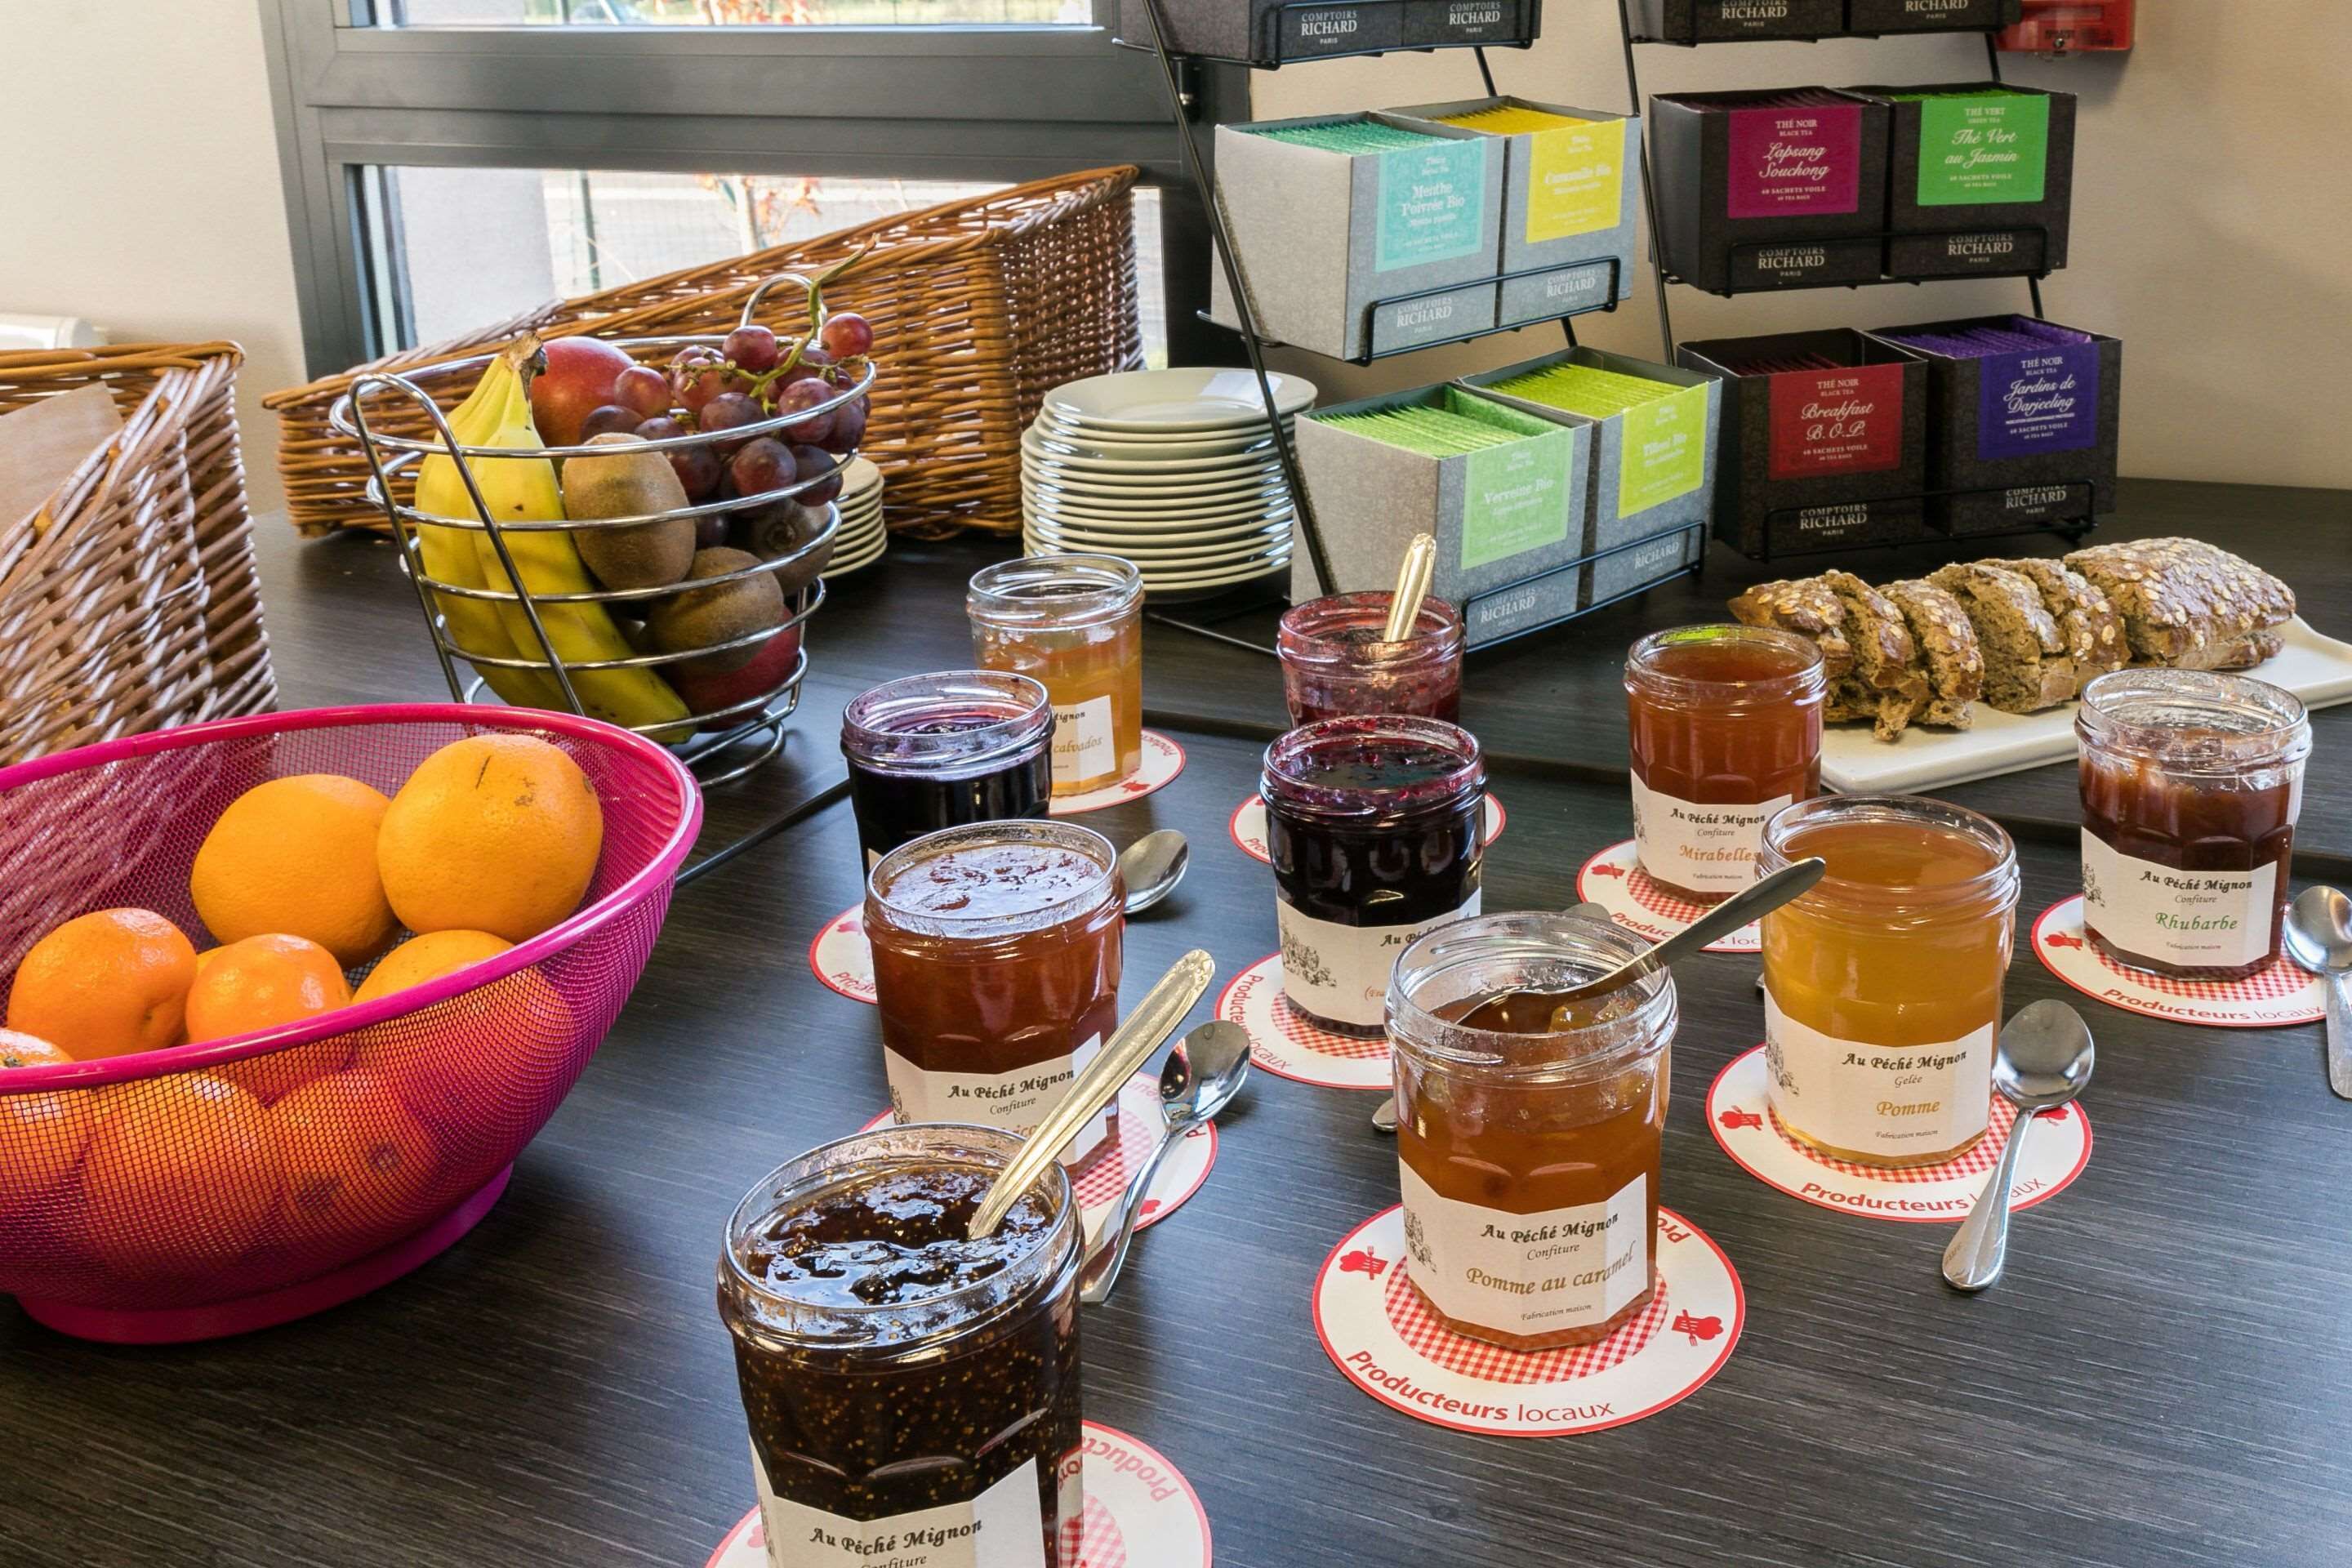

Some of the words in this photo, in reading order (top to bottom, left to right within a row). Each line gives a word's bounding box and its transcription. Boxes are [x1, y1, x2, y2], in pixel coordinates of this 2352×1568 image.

[1449, 11, 1500, 25] RICHARD
[1722, 7, 1788, 20] RICHARD
[1301, 20, 1357, 37] RICHARD
[1965, 107, 1982, 116] THÉ
[1984, 107, 2006, 115] VERT
[1775, 118, 1794, 129] THÉ
[1796, 119, 1818, 128] NOIR
[1952, 129, 1981, 145] Thé
[1986, 128, 2018, 144] Vert
[1762, 142, 1826, 163] Lapsang
[1944, 154, 1965, 164] au
[1962, 148, 2018, 169] Jasmin
[1759, 161, 1829, 181] Souchong
[1412, 183, 1453, 198] Menthe
[1948, 242, 2013, 256] RICHARD
[1758, 256, 1824, 270] RICHARD
[1547, 277, 1595, 297] RICHARD
[1396, 305, 1451, 327] RICHARD
[2020, 358, 2039, 368] THÉ
[2042, 356, 2063, 366] NOIR
[1816, 380, 1836, 390] THÉ
[1838, 378, 1859, 388] NOIR
[2003, 377, 2059, 402] Jardins
[2060, 373, 2077, 390] de
[1801, 399, 1874, 421] Breakfast
[2007, 393, 2076, 416] Darjeeling
[2005, 490, 2067, 509] RICHARD
[1799, 512, 1868, 530] RICHARD
[1634, 542, 1679, 570] RICHARD
[1480, 596, 1535, 623] RICHARD
[1670, 808, 1685, 819] Au
[1687, 813, 1719, 824] Péché
[1722, 814, 1766, 827] Mignon
[1697, 828, 1735, 839] Confiture
[2140, 871, 2159, 884] Au
[2163, 876, 2200, 890] Péché
[2203, 880, 2252, 893] Mignon
[2175, 894, 2217, 906] Confiture
[2155, 912, 2238, 930] Rhubarbe
[1381, 934, 1401, 947] Au
[2102, 988, 2250, 1020] Producteurs
[2253, 1005, 2325, 1020] locaux
[1842, 1053, 1866, 1066] Au
[1870, 1057, 1913, 1071] Péché
[1917, 1050, 1967, 1071] Mignon
[947, 1085, 970, 1098] Au
[973, 1083, 1015, 1098] Péché
[1019, 1070, 1074, 1094] Mignon
[1894, 1074, 1923, 1089] Gelée
[989, 1097, 1037, 1116] Confiture
[1876, 1101, 1940, 1116] Pomme
[1801, 1182, 1969, 1211] Producteurs
[1481, 1224, 1506, 1240] Au
[1511, 1225, 1557, 1244] Péché
[1562, 1212, 1619, 1237] Mignon
[1527, 1244, 1580, 1261] Confiture
[1466, 1267, 1535, 1295] Pomme
[1541, 1276, 1567, 1291] au
[1572, 1241, 1636, 1287] caramel
[1521, 1307, 1564, 1321] Fabrication
[1566, 1304, 1592, 1315] maison
[1346, 1350, 1508, 1420] Producteurs
[1517, 1400, 1615, 1422] locaux
[809, 1527, 836, 1547] Au
[841, 1535, 896, 1556] Péché
[903, 1519, 982, 1547] Mignon
